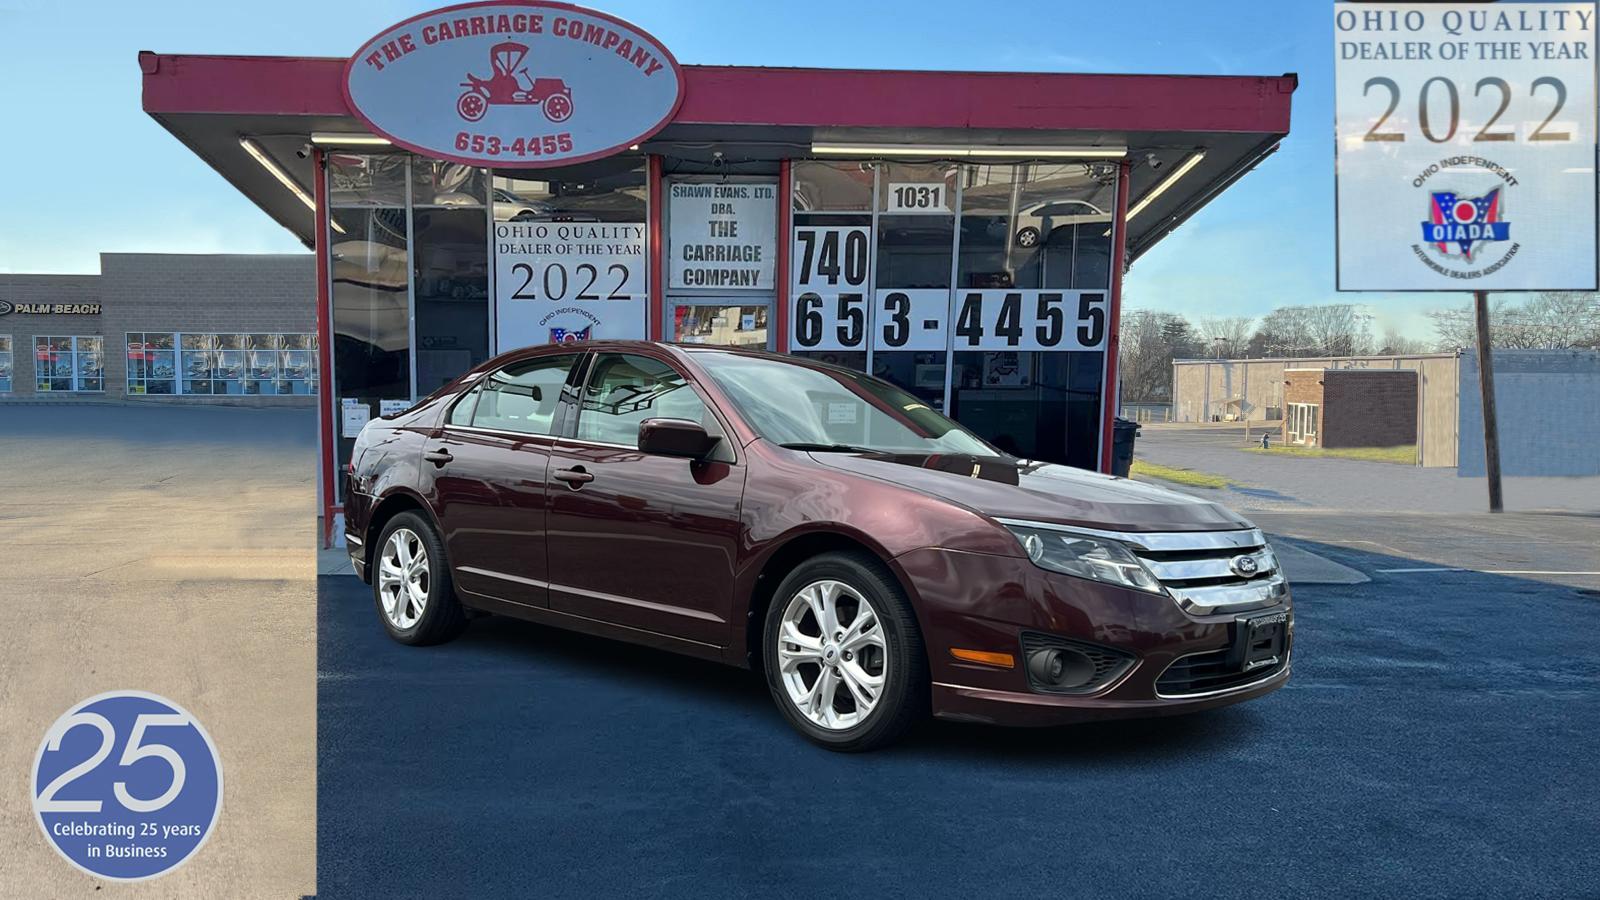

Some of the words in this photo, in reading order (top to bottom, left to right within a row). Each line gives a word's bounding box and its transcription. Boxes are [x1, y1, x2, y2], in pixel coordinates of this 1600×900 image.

[1336, 10, 1425, 31] OHIO
[1442, 10, 1592, 36] QUALITY
[365, 33, 417, 71] THE
[422, 14, 544, 45] CARRIAGE
[552, 17, 664, 77] COMPANY
[1341, 42, 1433, 60] DEALER
[1439, 42, 1469, 60] OF
[1475, 42, 1522, 60] THE
[1528, 42, 1589, 60] YEAR
[1363, 76, 1571, 143] 2022
[455, 132, 573, 157] 653-4455
[1412, 163, 1440, 188] OHIO
[1440, 155, 1519, 187] INDEPENDENT
[673, 185, 711, 198] SHAWN
[754, 187, 775, 200] LTD.
[894, 187, 940, 208] 1031
[711, 203, 736, 215] DBA.
[497, 225, 548, 239] OHIO
[557, 226, 643, 240] QUALITY
[708, 220, 738, 238] THE
[1432, 224, 1495, 240] OIADA
[500, 243, 552, 255] DEALER
[555, 244, 574, 255] OF
[577, 244, 603, 255] THE
[607, 244, 642, 255] YEAR
[683, 244, 762, 262] CARRIAGE
[797, 229, 868, 286] 740
[1411, 244, 1450, 277] AUTOMOBILE
[1449, 269, 1482, 280] DEALERS
[1482, 242, 1521, 276] ASSOCIATION
[511, 262, 632, 301] 2022
[683, 268, 761, 286] COMPANY
[15, 303, 51, 314] PALM
[54, 304, 100, 315] BEACH
[538, 311, 555, 327] OHIO
[555, 306, 601, 327] INDEPENDENT
